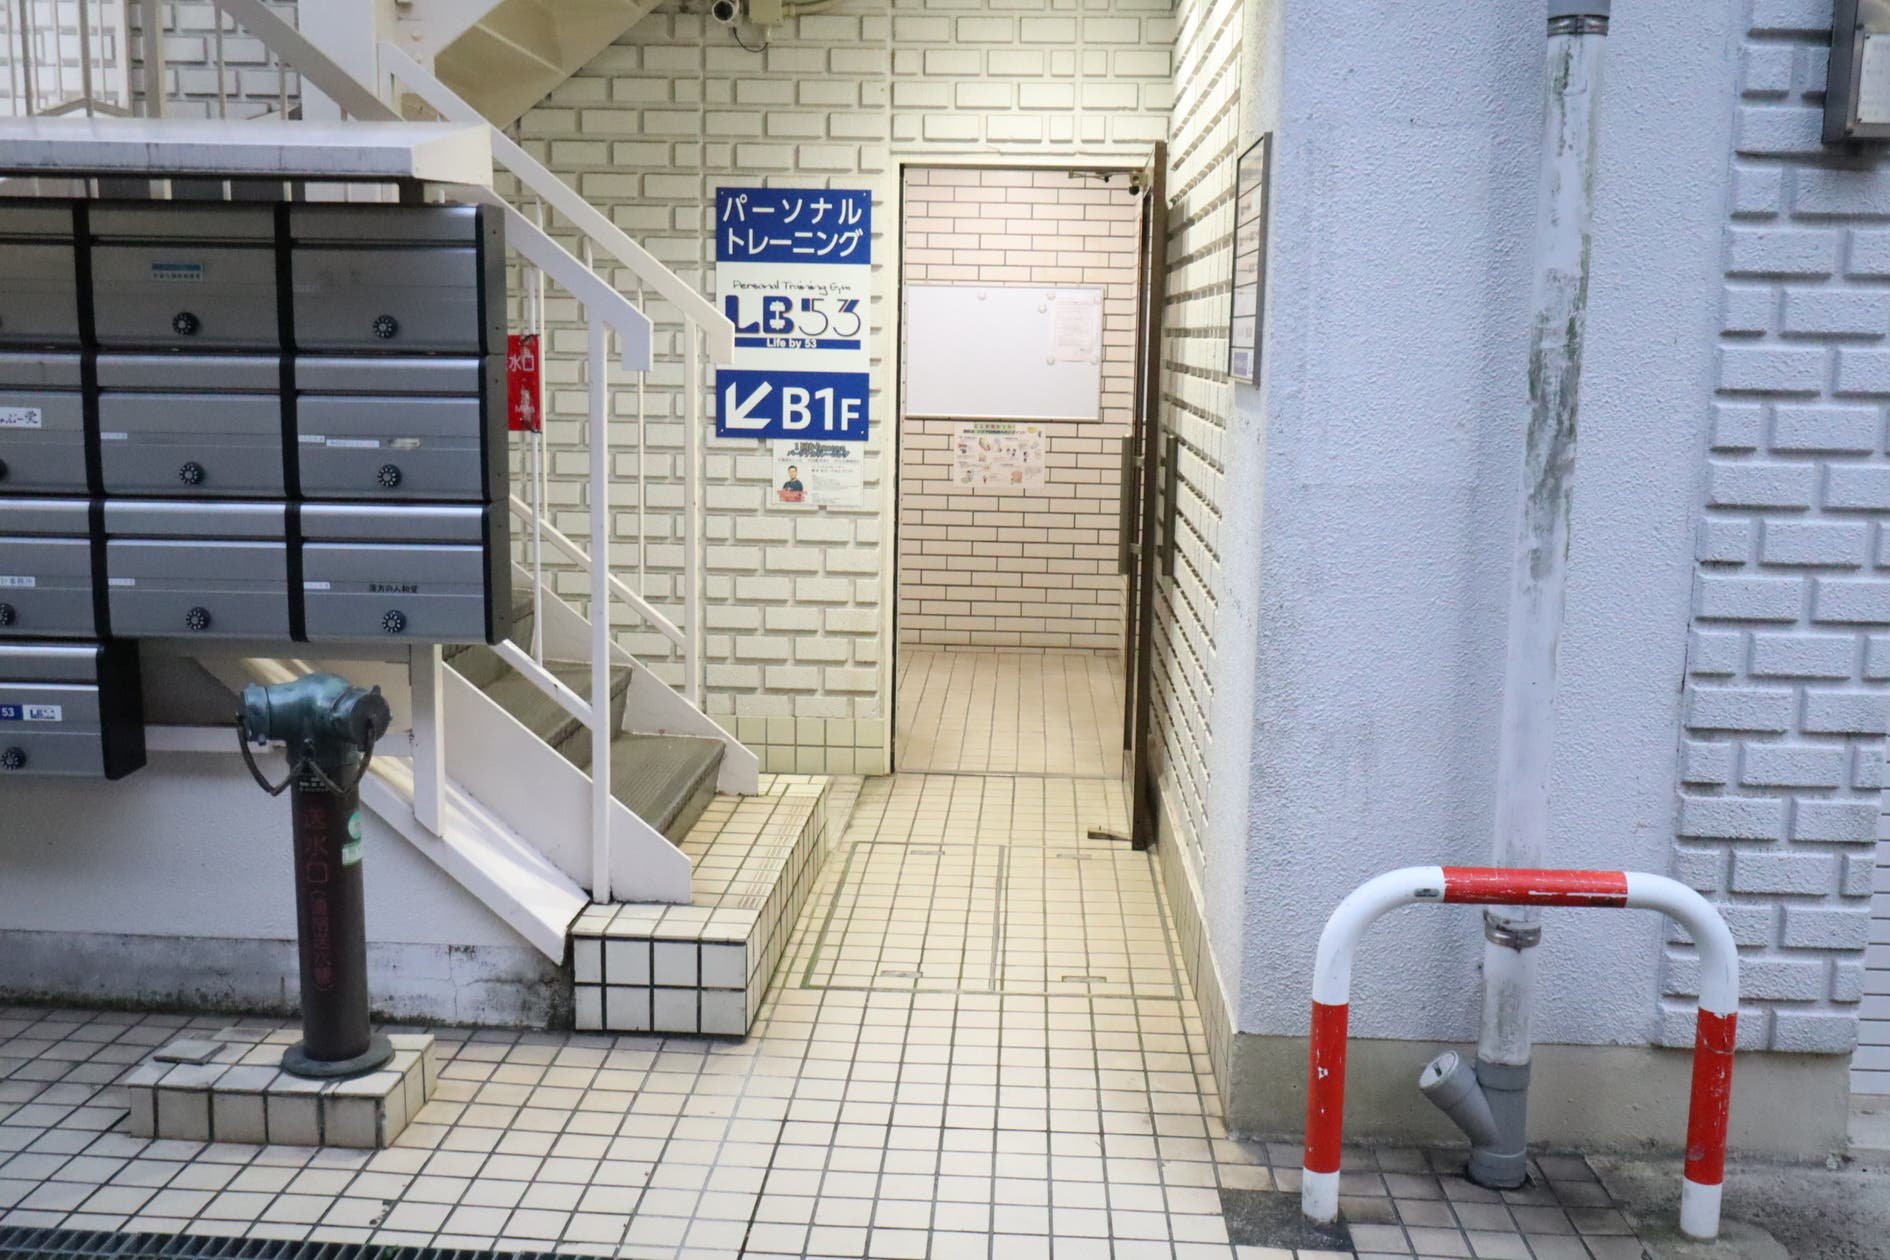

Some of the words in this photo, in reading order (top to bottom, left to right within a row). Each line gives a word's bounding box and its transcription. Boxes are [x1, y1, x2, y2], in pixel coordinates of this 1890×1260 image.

[722, 194, 862, 226] パーソナル
[727, 227, 864, 257] トレーニング
[732, 279, 780, 291] Personal
[782, 280, 829, 296] Training
[829, 281, 852, 295] Gym
[766, 337, 787, 349] Life
[789, 337, 803, 350] by
[804, 338, 818, 350] 53
[782, 386, 861, 431] B1F
